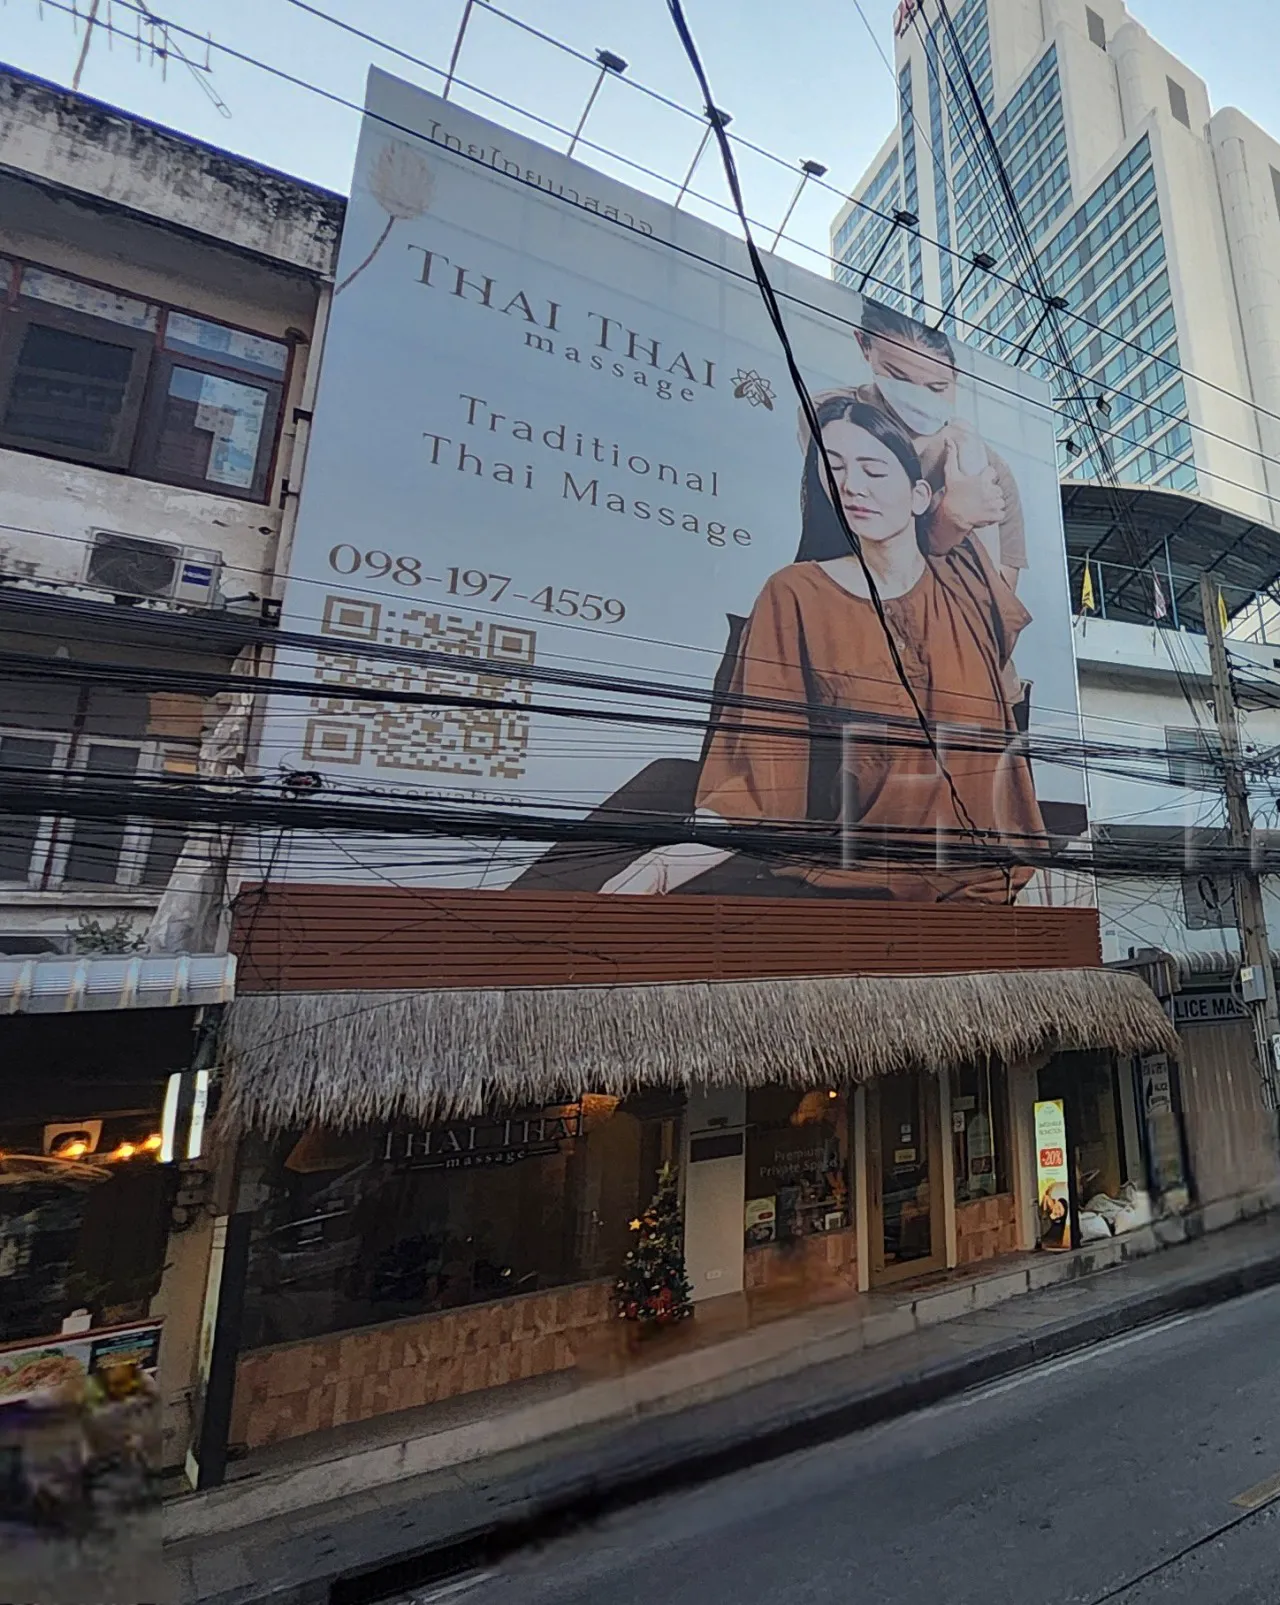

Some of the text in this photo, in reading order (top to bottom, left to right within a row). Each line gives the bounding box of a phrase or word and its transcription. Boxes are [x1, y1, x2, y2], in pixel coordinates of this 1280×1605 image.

[406, 244, 717, 390] THAI THAI
[523, 328, 697, 403] massage
[422, 431, 754, 548] Thai Massage
[459, 393, 719, 497] Traditional
[328, 543, 627, 624] 098-197-4559
[445, 1150, 526, 1169] massage
